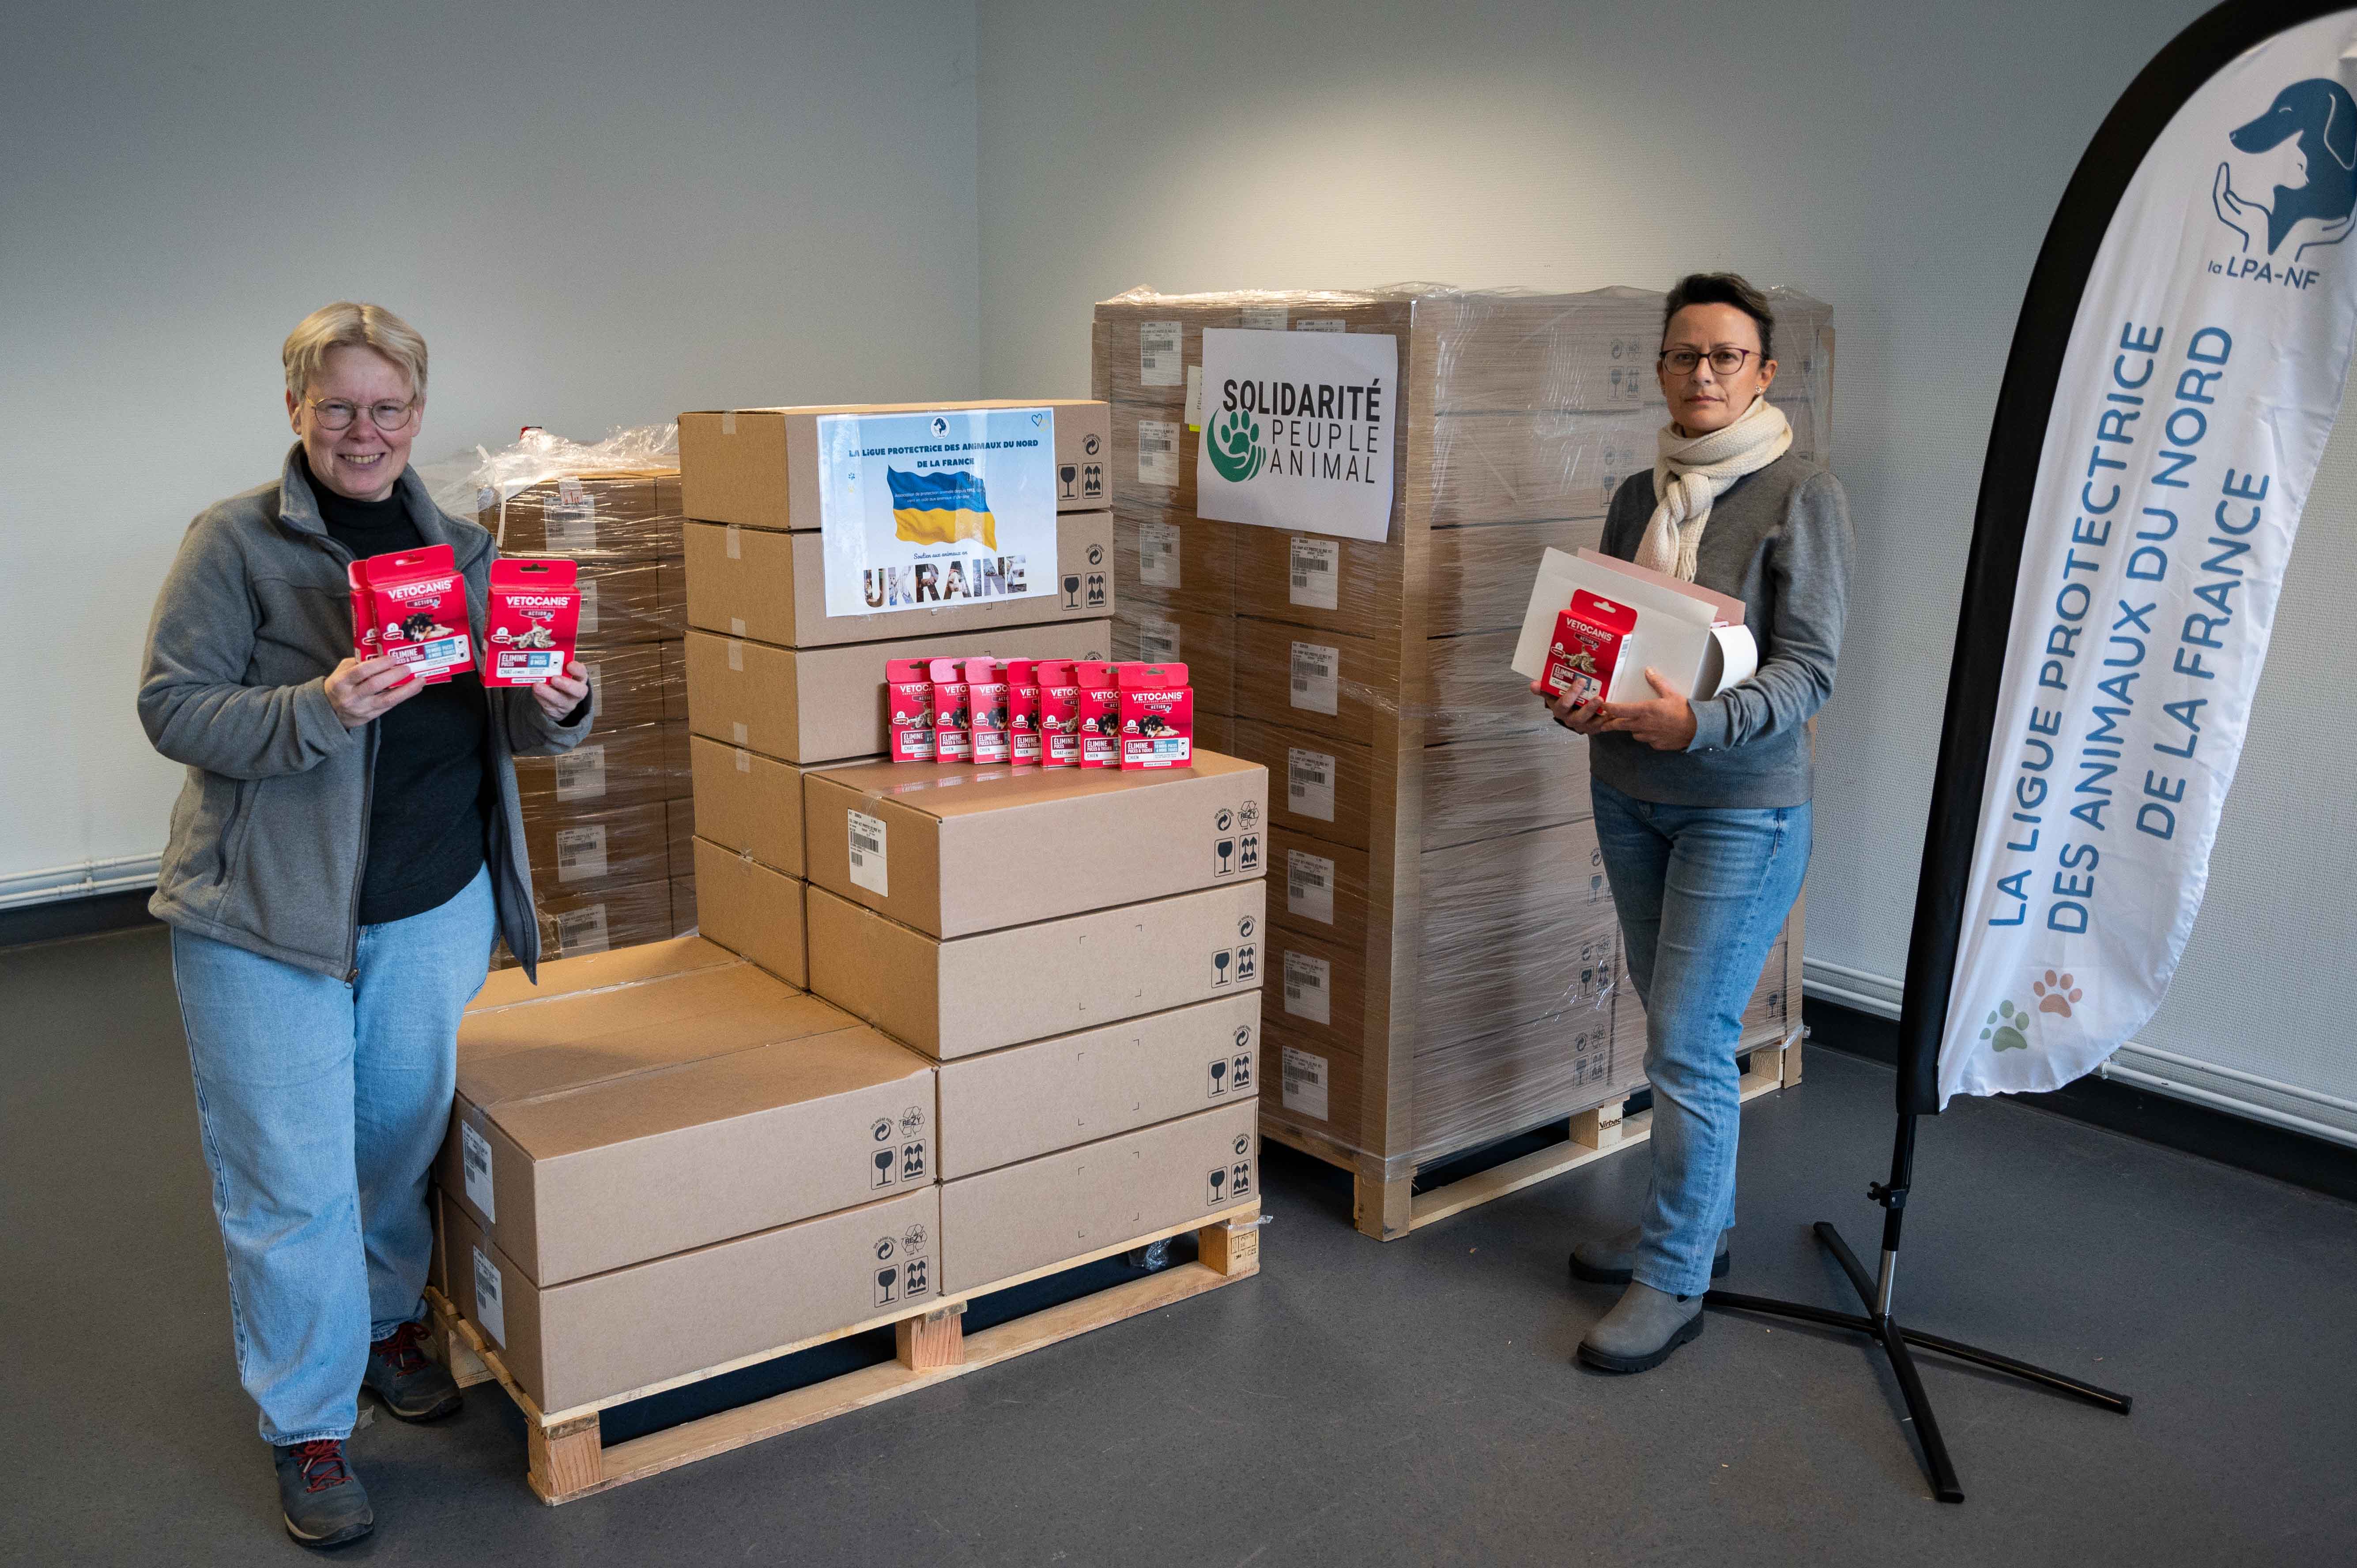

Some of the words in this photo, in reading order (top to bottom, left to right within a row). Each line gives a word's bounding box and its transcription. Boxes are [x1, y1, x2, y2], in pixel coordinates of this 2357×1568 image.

[2207, 260, 2222, 274] la
[2226, 256, 2320, 290] LPA-NF
[1222, 378, 1381, 422] SOLIDARITÉ
[2151, 326, 2233, 488] NORD
[942, 458, 974, 466] FRANCE
[1272, 419, 1379, 453] PEUPLE
[1270, 448, 1375, 484] ANIMAL
[2038, 322, 2164, 690] PROTECTRICE
[2125, 508, 2179, 582] DU
[2173, 468, 2271, 679] FRANCE
[863, 554, 1027, 608] UKRAINE
[2068, 599, 2158, 831] ANIMAUX
[2153, 698, 2208, 759] LA
[2006, 705, 2063, 855] LIGUE
[2136, 769, 2187, 841] DE
[1241, 808, 1256, 819] REZY
[1988, 867, 2032, 929] LA
[2048, 840, 2101, 935] DES
[902, 1116, 921, 1127] REZY
[1599, 1117, 1622, 1128] Virbac
[905, 1233, 924, 1244] REZY
